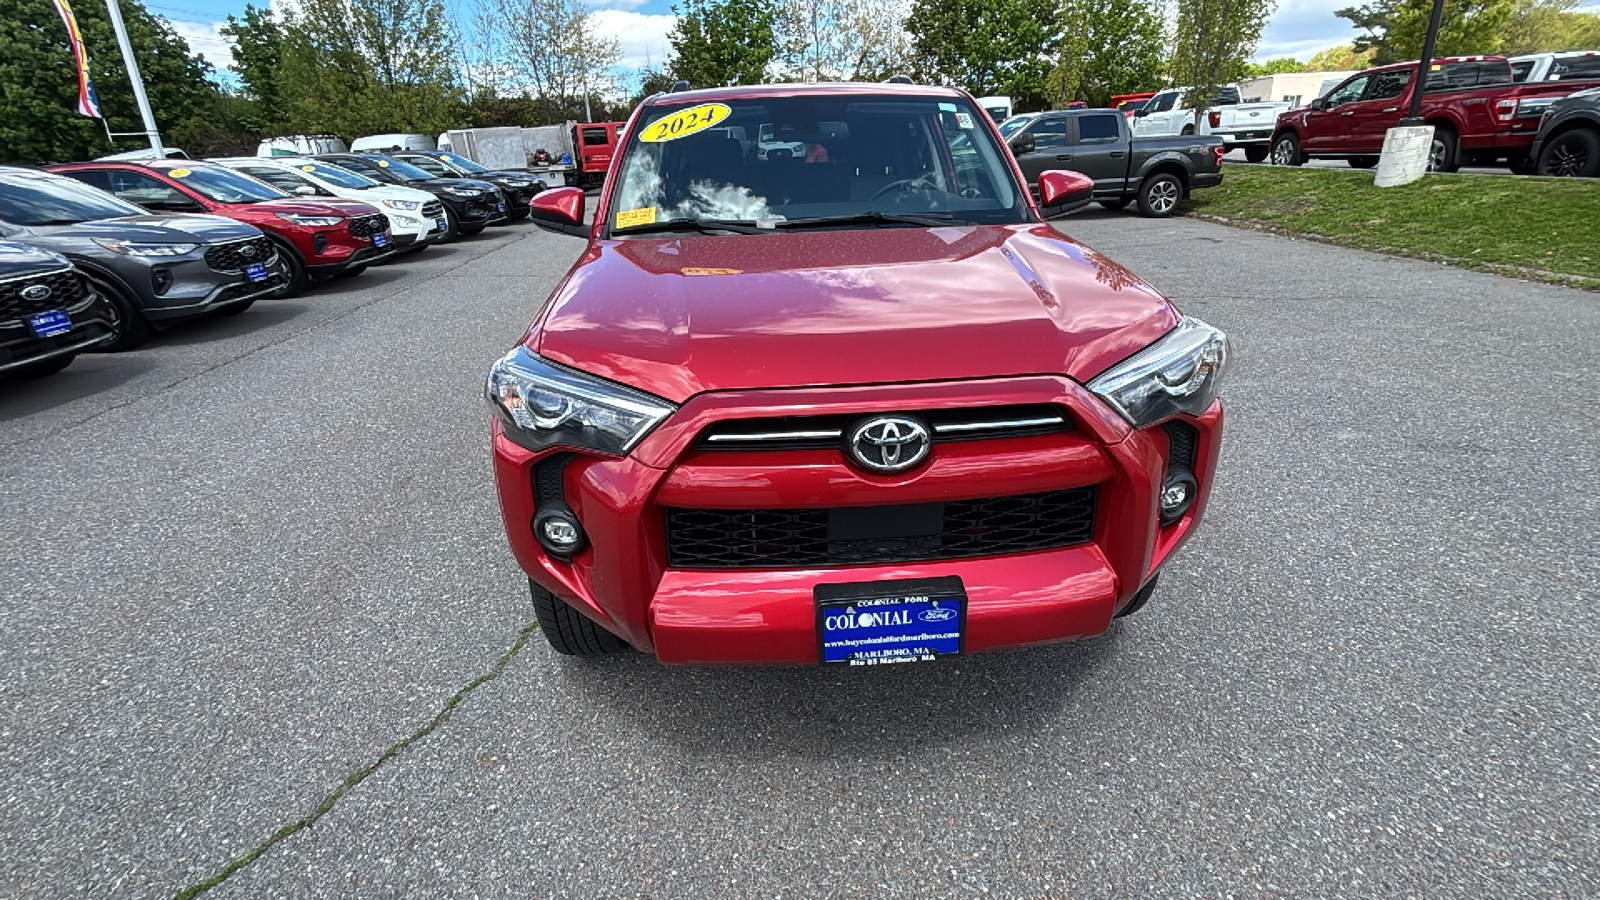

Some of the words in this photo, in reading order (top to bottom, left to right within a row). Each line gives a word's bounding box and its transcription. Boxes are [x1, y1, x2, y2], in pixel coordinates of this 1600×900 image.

[655, 107, 714, 140] 2024
[857, 598, 900, 607] COLONIAL
[904, 596, 929, 604] FORD
[825, 610, 912, 630] COLONIAL
[925, 611, 950, 620] Ford
[824, 632, 960, 647] www.buycolonialfordmarlboro.com
[855, 648, 912, 659] MARLBORO,
[913, 647, 930, 655] MA
[850, 658, 865, 666] Rte
[880, 656, 917, 664] Marlboro
